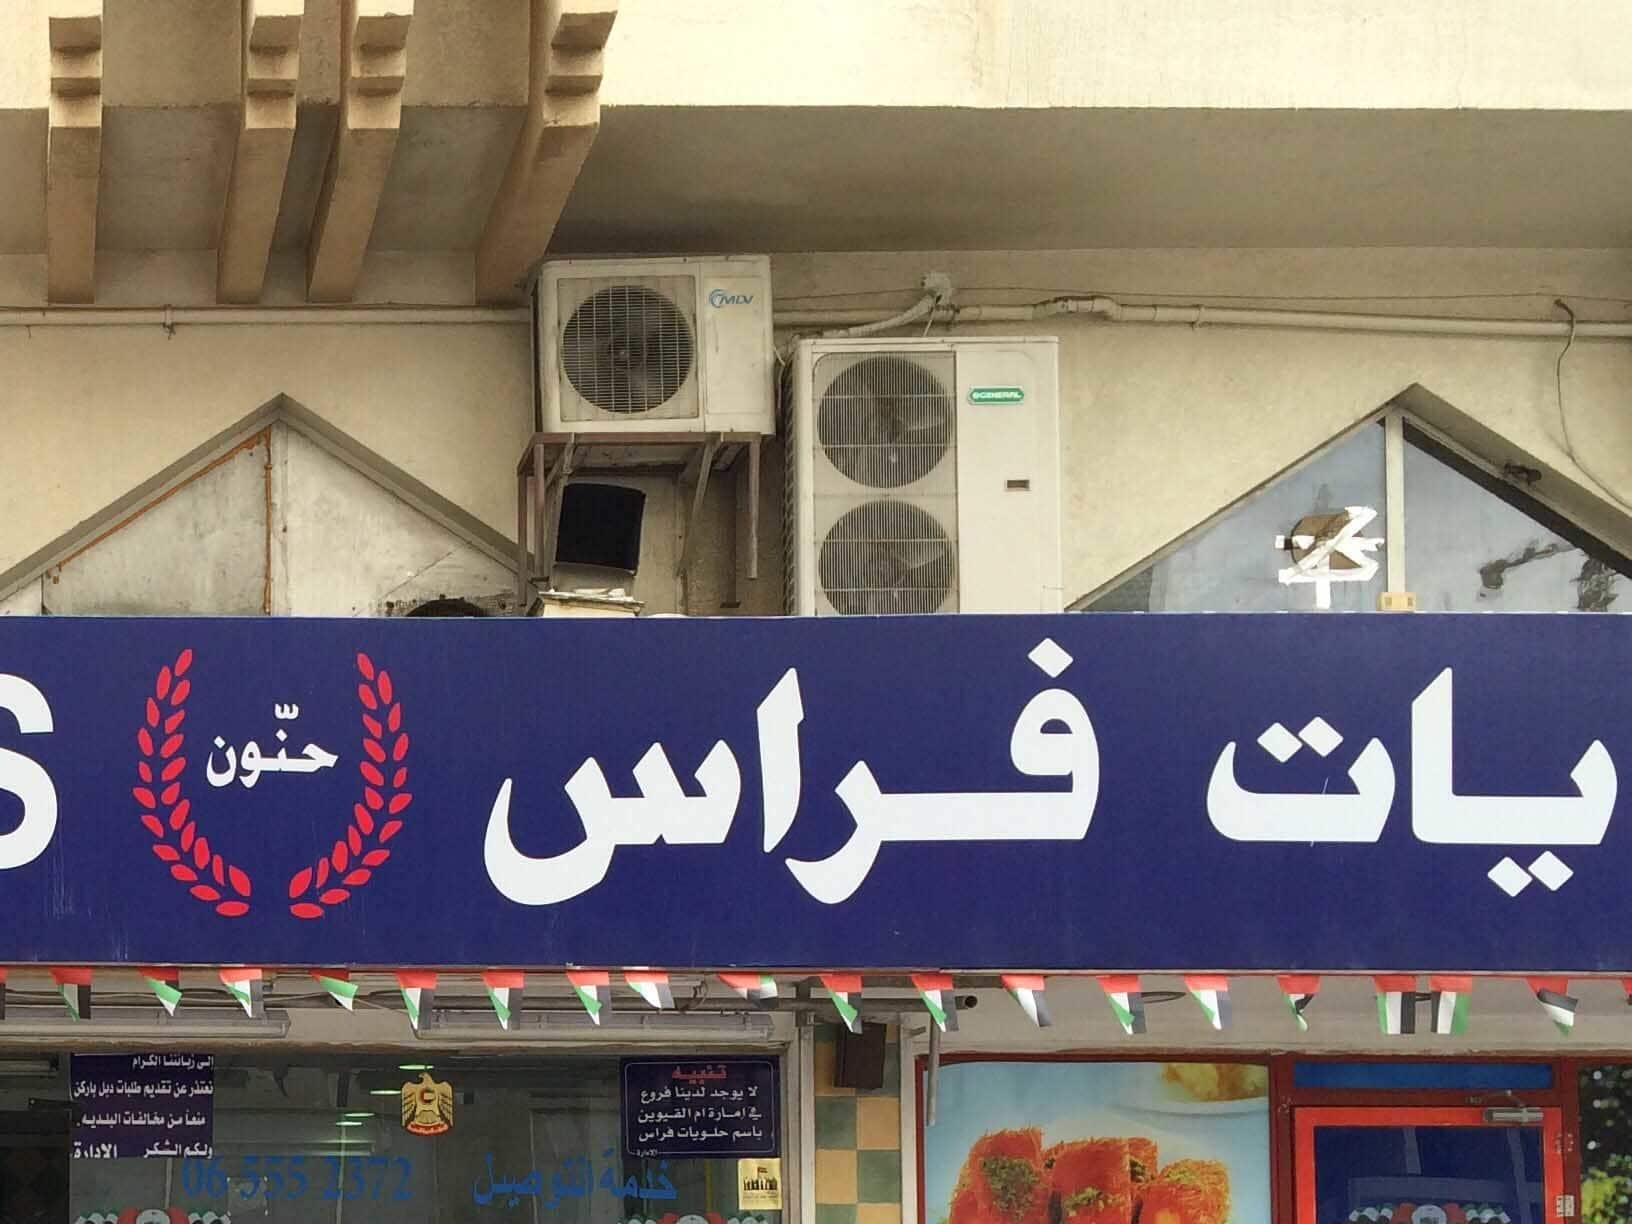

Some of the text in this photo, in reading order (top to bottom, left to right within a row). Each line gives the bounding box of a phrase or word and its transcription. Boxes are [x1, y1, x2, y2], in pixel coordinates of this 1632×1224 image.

[484, 637, 1100, 906] فراس
[672, 1065, 728, 1085] تنبيه
[143, 1079, 172, 1098] تقديم
[173, 1082, 187, 1097] عن
[710, 1088, 744, 1101] يوجد
[167, 1113, 183, 1128] من
[638, 1126, 674, 1142] فراس
[143, 1139, 182, 1158] الشكر
[184, 1142, 213, 1159] ولكم
[181, 1156, 227, 1199] 06
